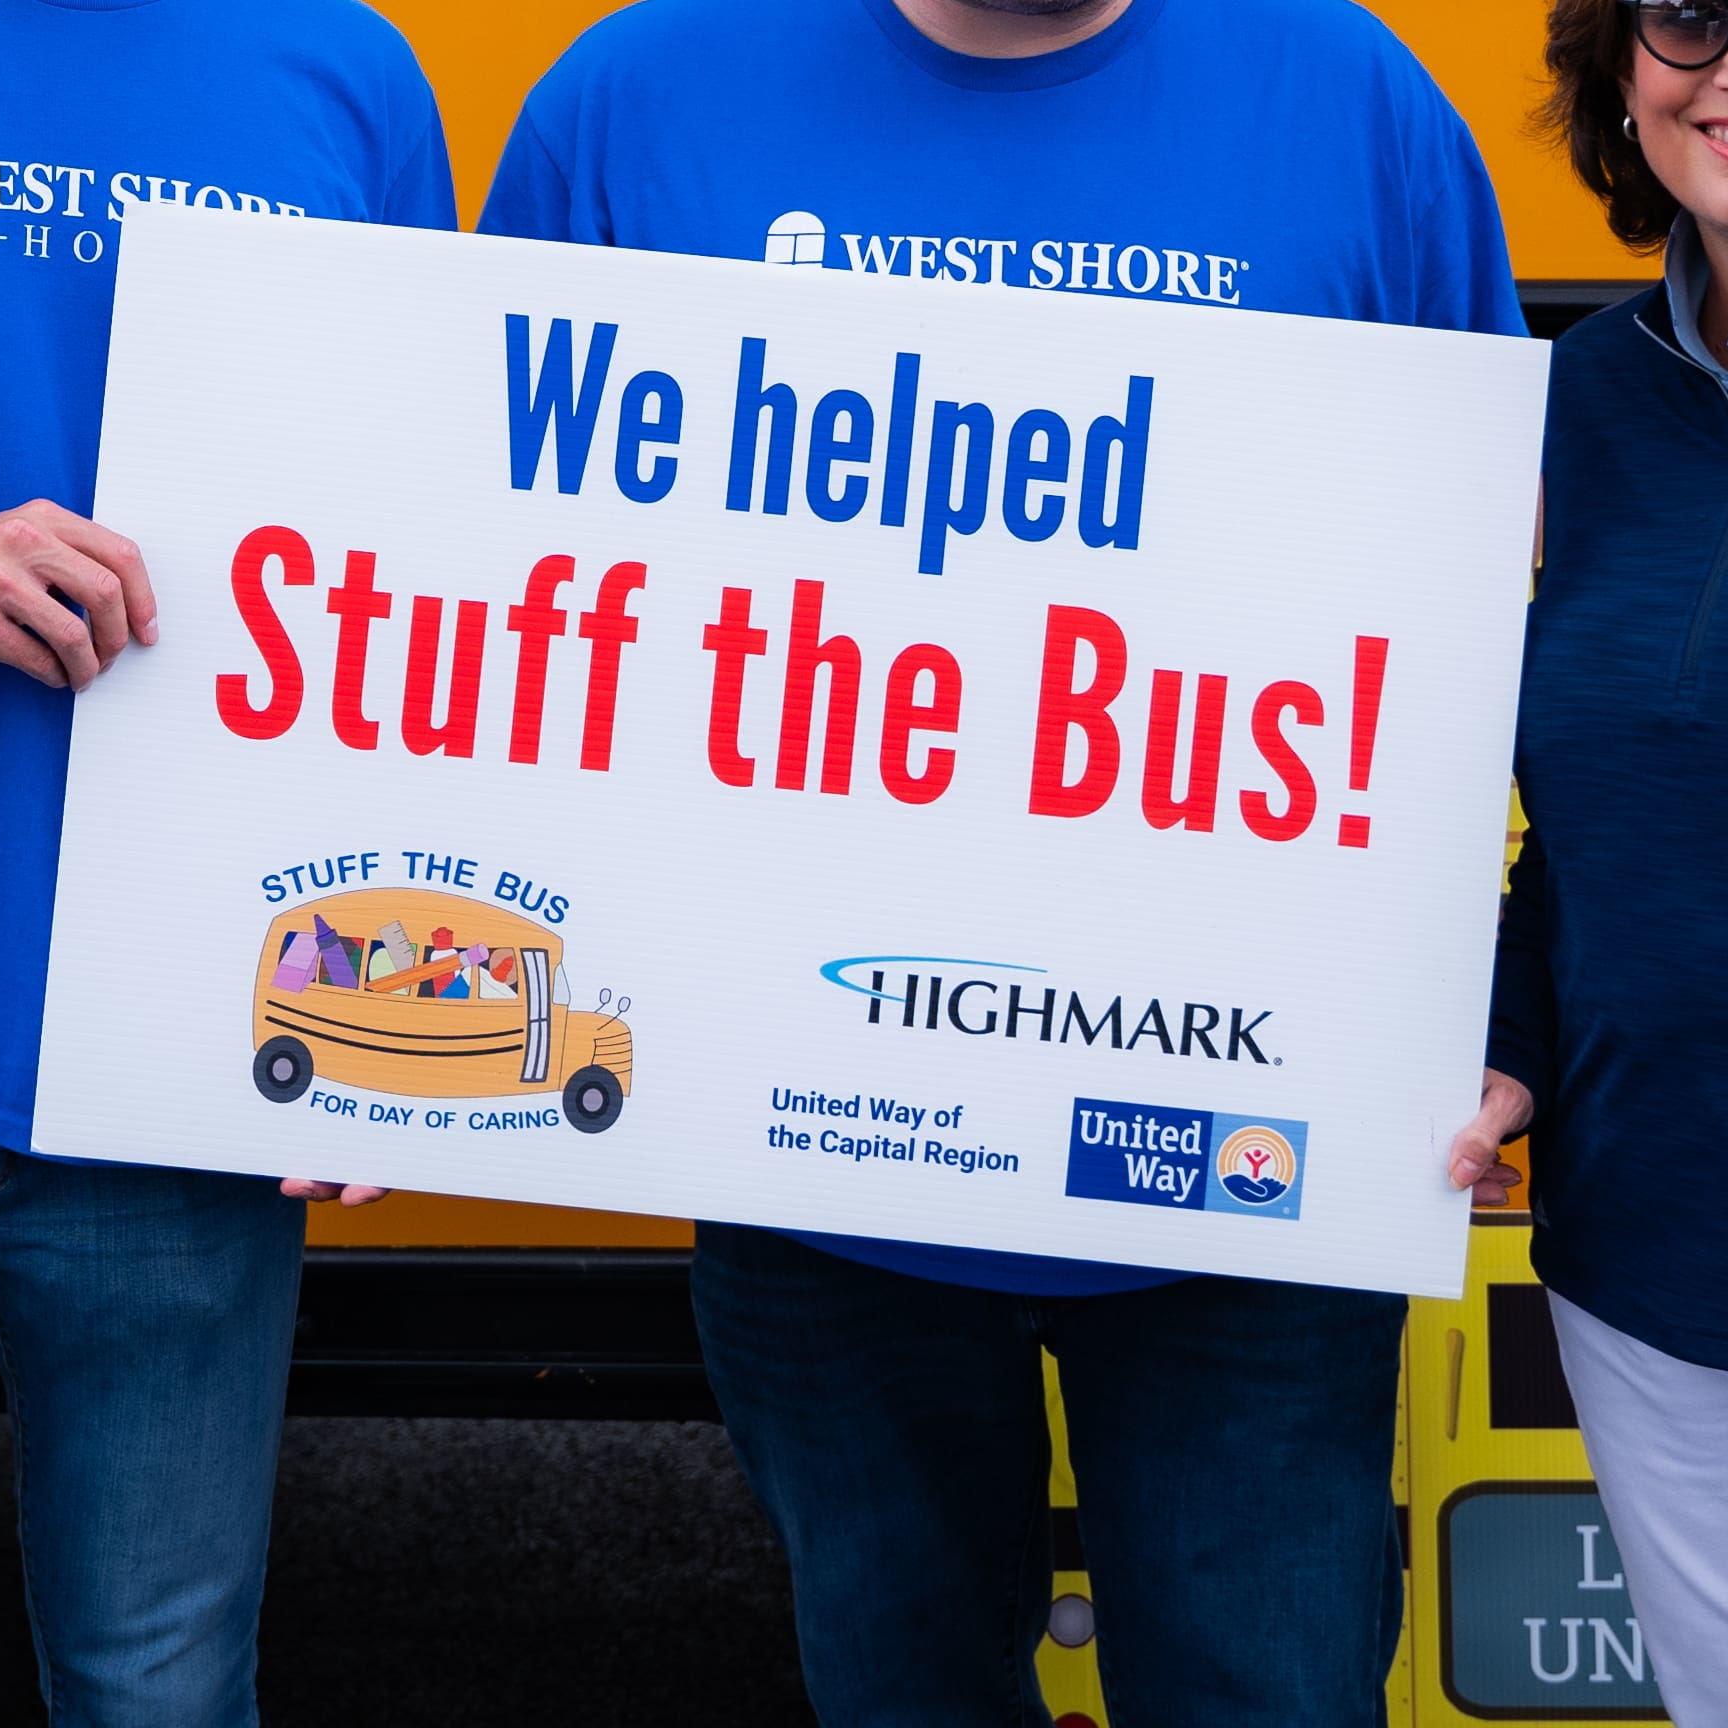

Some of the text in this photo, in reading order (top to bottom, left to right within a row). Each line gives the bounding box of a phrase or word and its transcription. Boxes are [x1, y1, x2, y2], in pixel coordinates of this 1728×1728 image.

[22, 224, 104, 264] HO
[840, 234, 1241, 305] WEST SHORE
[504, 312, 1156, 577] We helped
[215, 525, 1390, 849] Stuff the Bus!
[261, 850, 570, 924] STUFF THE BUS
[868, 968, 1271, 1066] HIGHMARK
[309, 1090, 561, 1131] FOR DAY OF CARING
[772, 1087, 964, 1129] United Way of
[1079, 1109, 1203, 1155] United
[767, 1125, 1019, 1174] the Capital Region
[1124, 1153, 1200, 1203] Way
